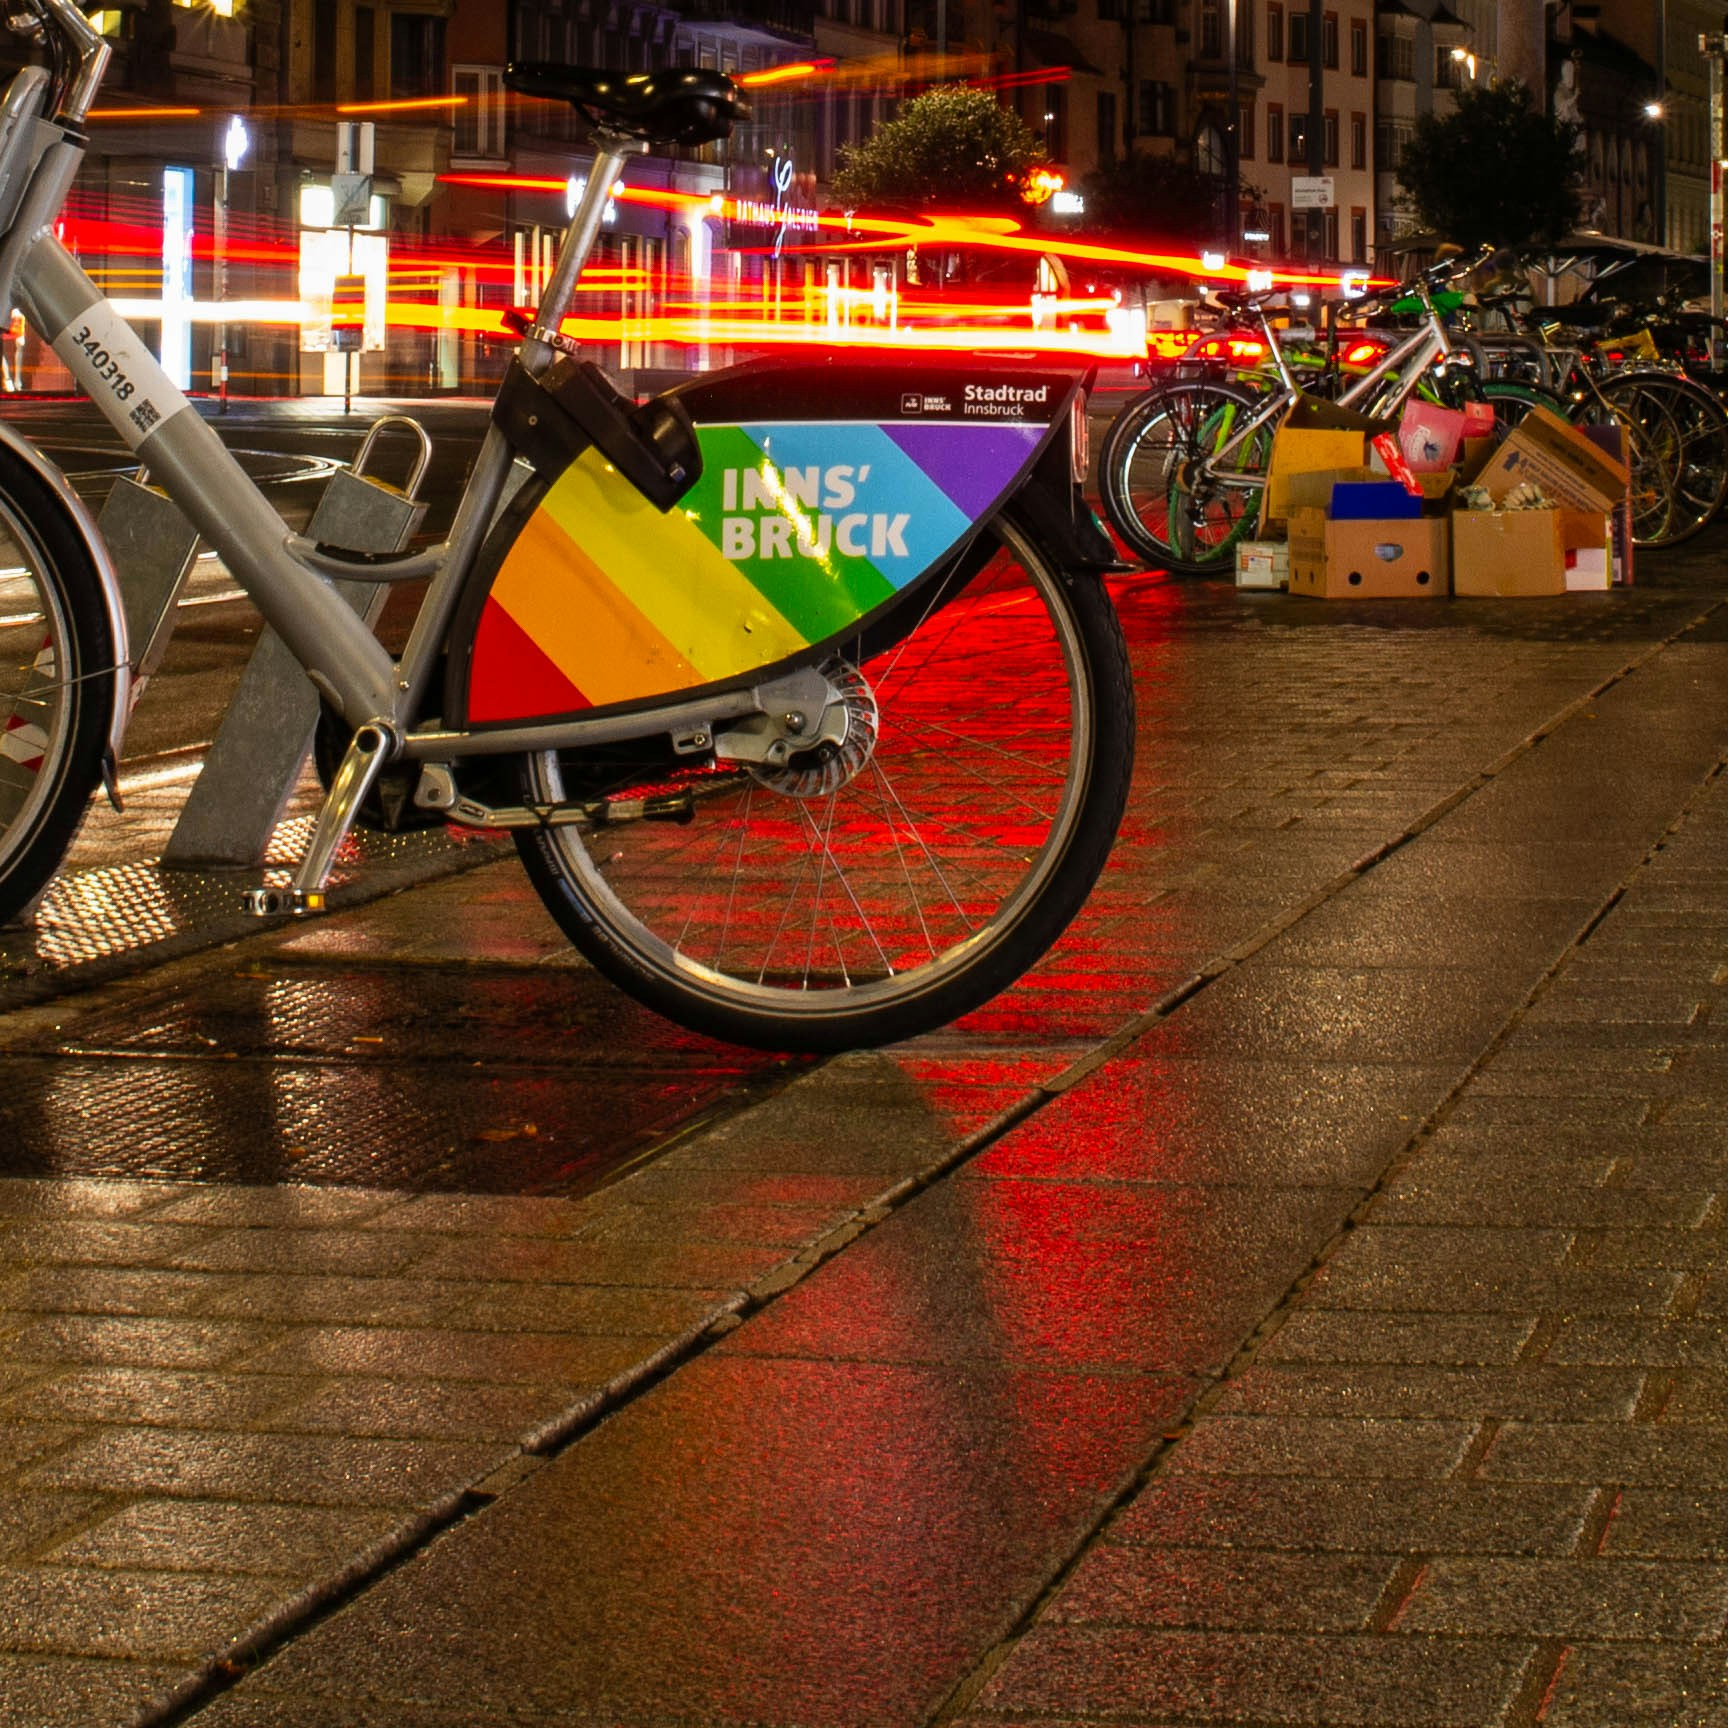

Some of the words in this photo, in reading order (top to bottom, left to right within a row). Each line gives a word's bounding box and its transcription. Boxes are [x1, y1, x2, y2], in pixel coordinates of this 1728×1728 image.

[72, 326, 135, 401] 340318
[963, 402, 1025, 416] Innsbruck
[964, 384, 1048, 402] Stadtrad
[722, 512, 912, 561] BRUCK
